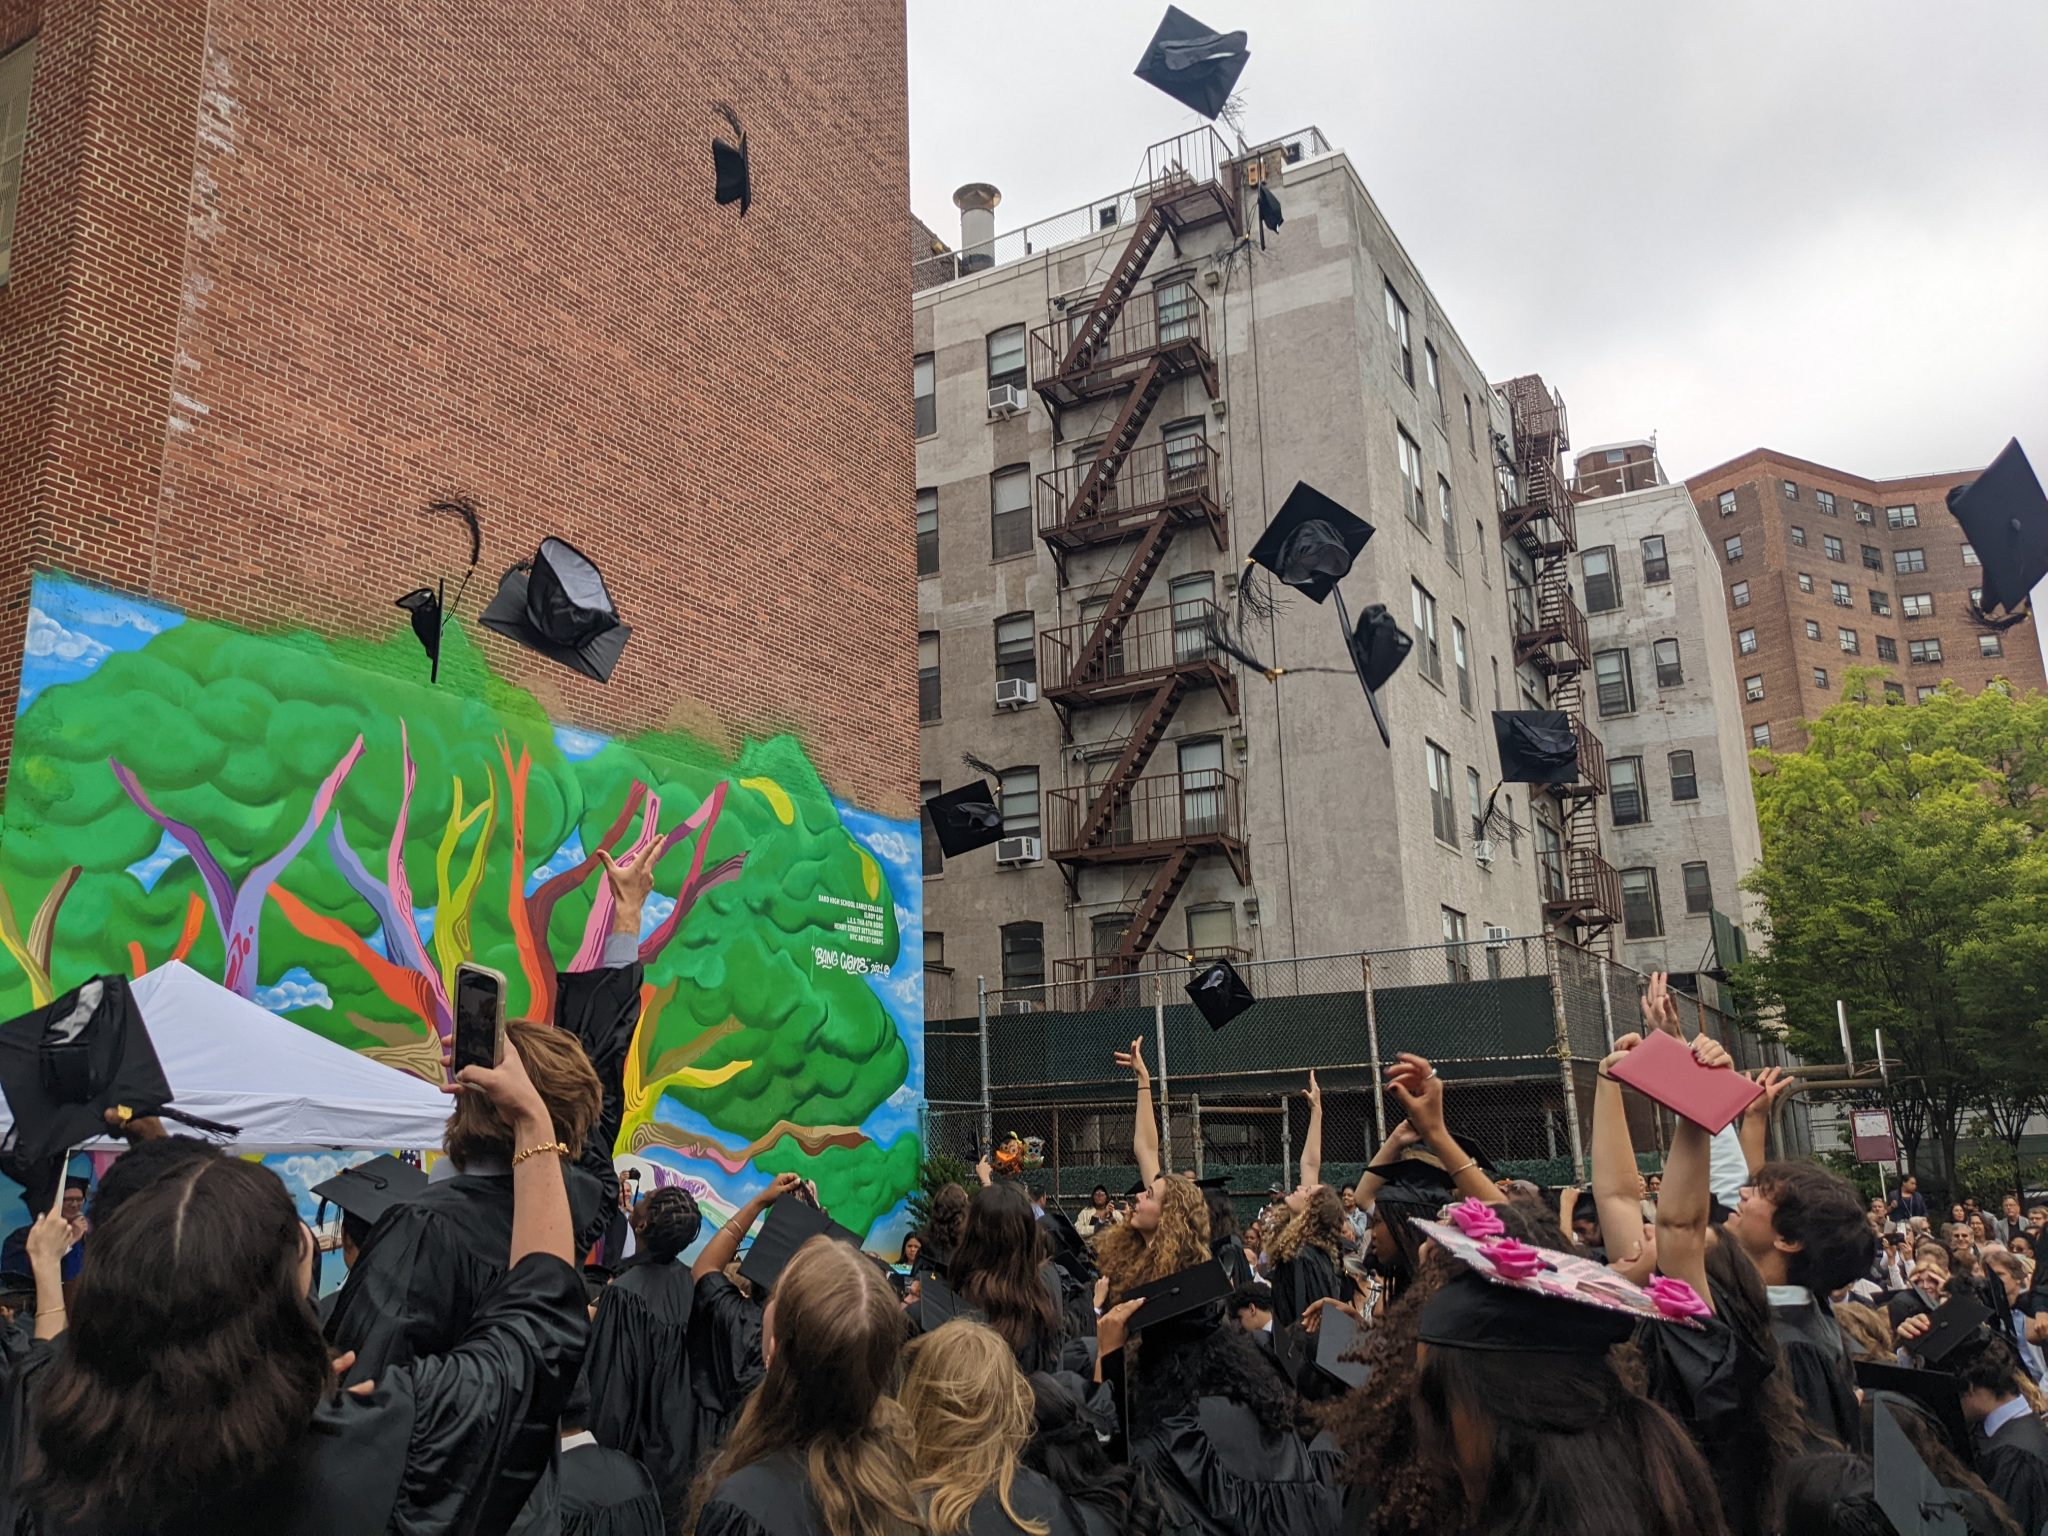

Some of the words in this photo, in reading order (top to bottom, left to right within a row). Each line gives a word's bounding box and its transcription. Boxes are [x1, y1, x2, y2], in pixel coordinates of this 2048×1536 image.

[819, 895, 829, 903] BARD
[840, 899, 855, 908] SCHOOL
[856, 902, 867, 911] EARLY
[868, 905, 883, 914] COLLEGE
[834, 922, 847, 930] HENRY
[847, 925, 861, 933] STREET
[861, 927, 883, 937] SETTLEMENT
[850, 933, 858, 941] NYC
[858, 935, 871, 943] ARTIST
[872, 937, 883, 946] CORPS
